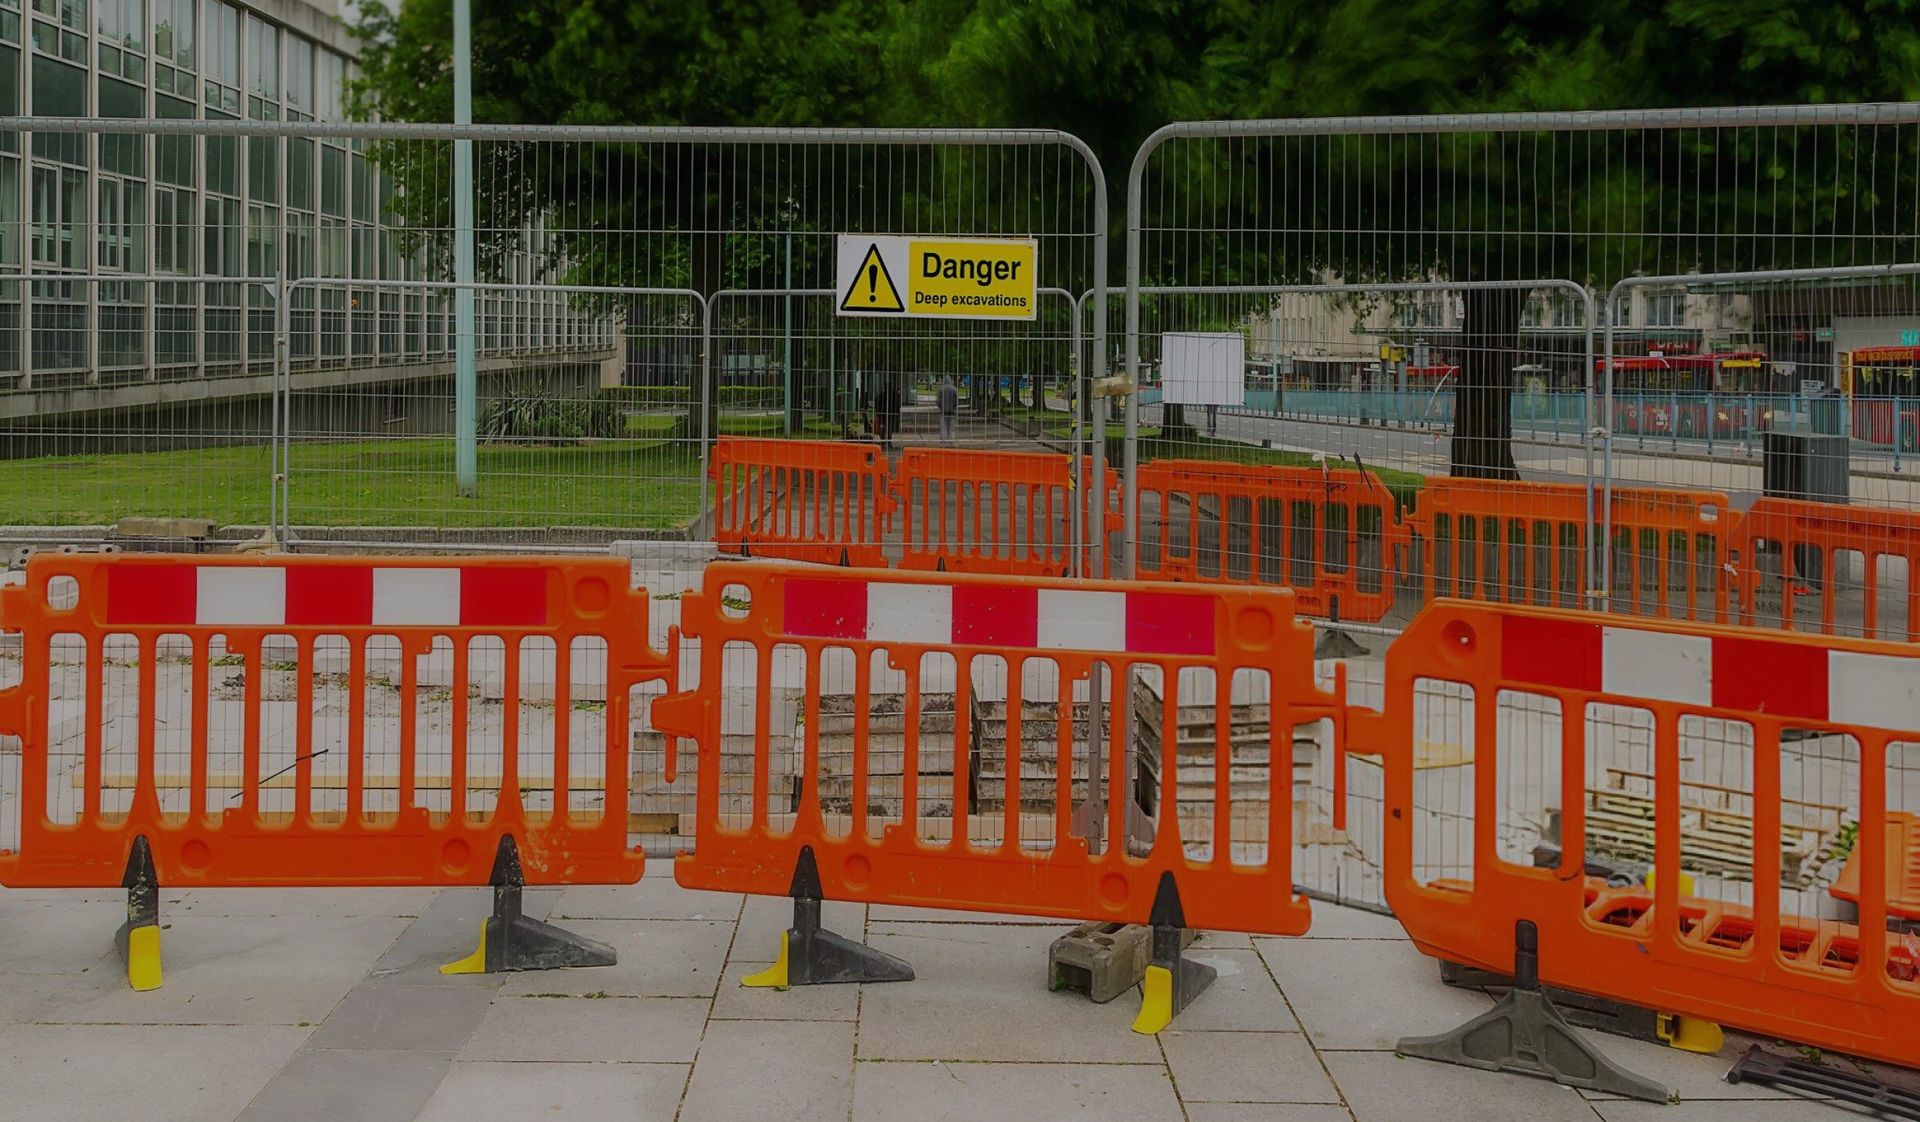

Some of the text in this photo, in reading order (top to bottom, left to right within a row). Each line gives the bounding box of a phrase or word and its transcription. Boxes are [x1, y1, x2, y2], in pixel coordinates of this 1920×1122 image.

[922, 252, 1022, 287] Danger
[915, 291, 1027, 308] Deep excavations
